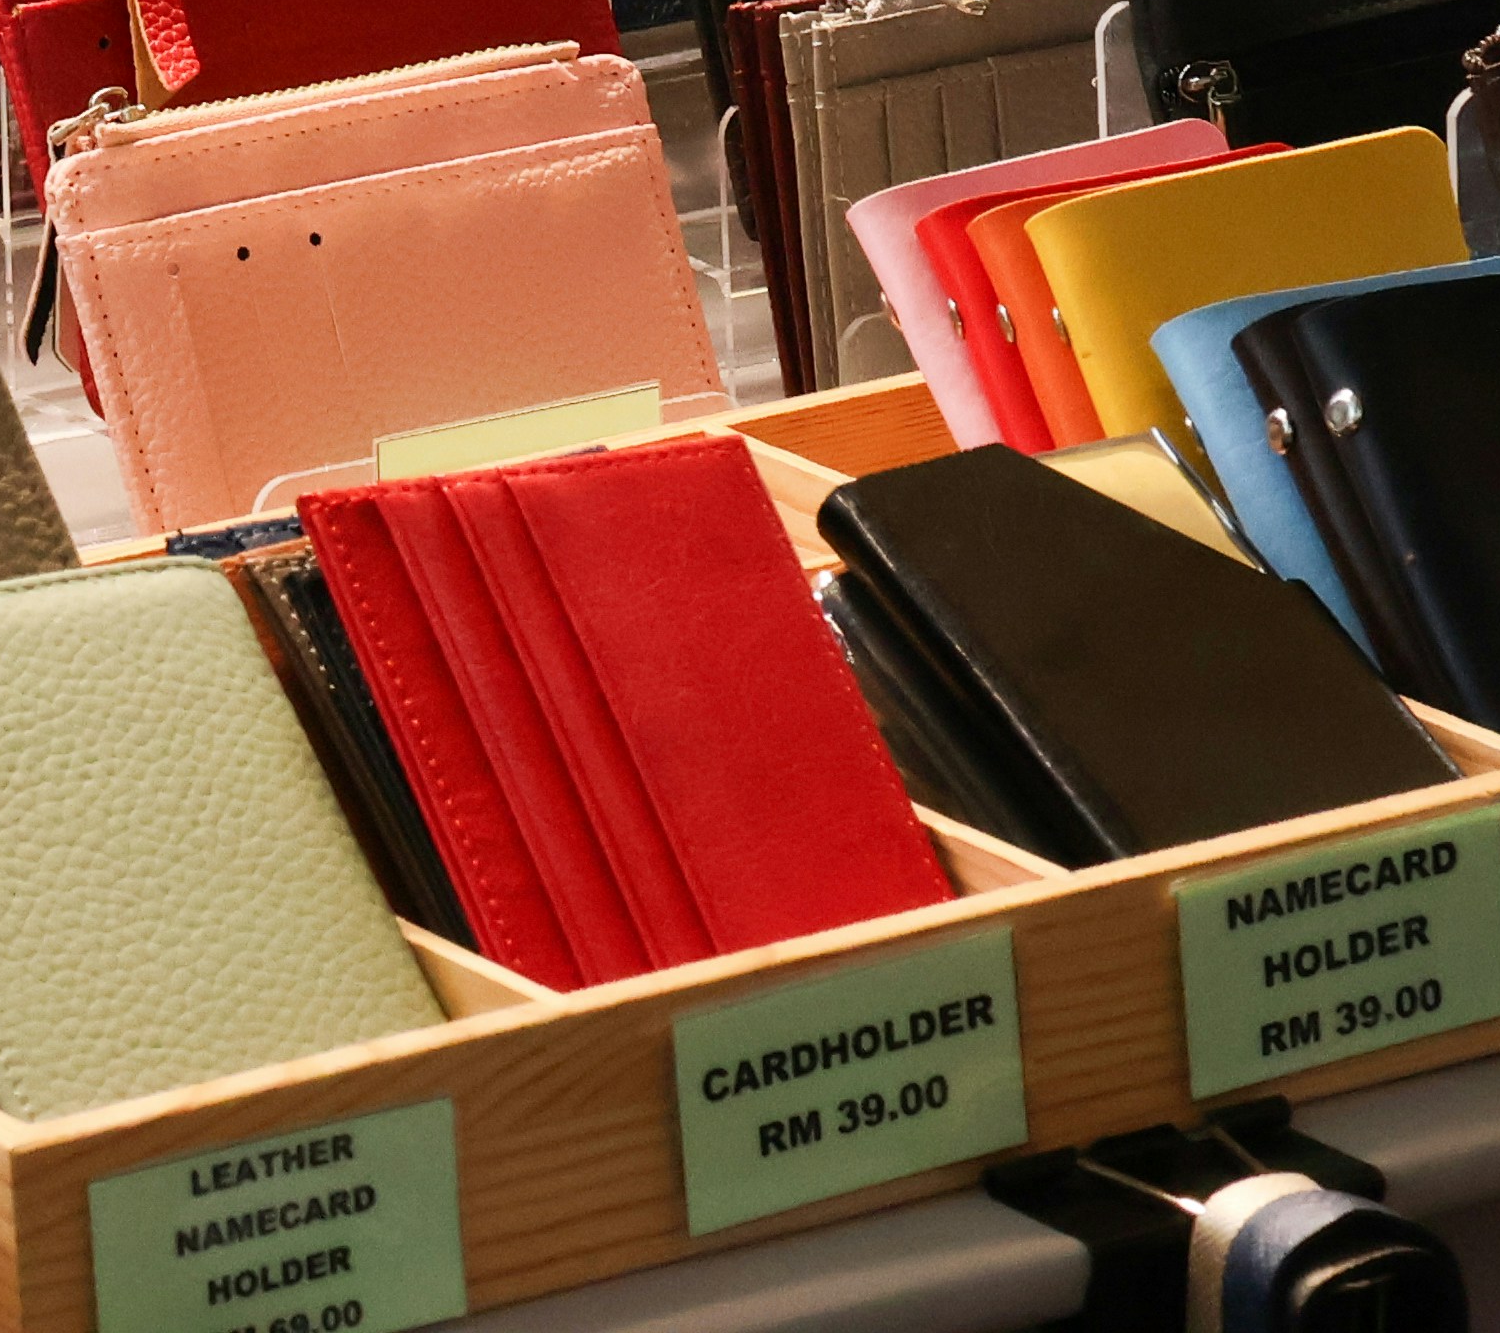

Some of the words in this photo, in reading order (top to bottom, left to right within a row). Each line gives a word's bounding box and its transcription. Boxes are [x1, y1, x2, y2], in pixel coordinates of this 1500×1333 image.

[1226, 840, 1458, 930] NAMECARD
[1263, 915, 1431, 988] HOLDER
[702, 993, 995, 1103] CARDHOLDER
[1260, 1011, 1321, 1057] RM
[1335, 978, 1442, 1037] 39.00
[758, 1109, 822, 1158] RM
[837, 1075, 949, 1135] 39.00
[189, 1133, 354, 1197] LEATHER
[175, 1184, 377, 1257] NAMECARD
[207, 1245, 353, 1306] HOLDER
